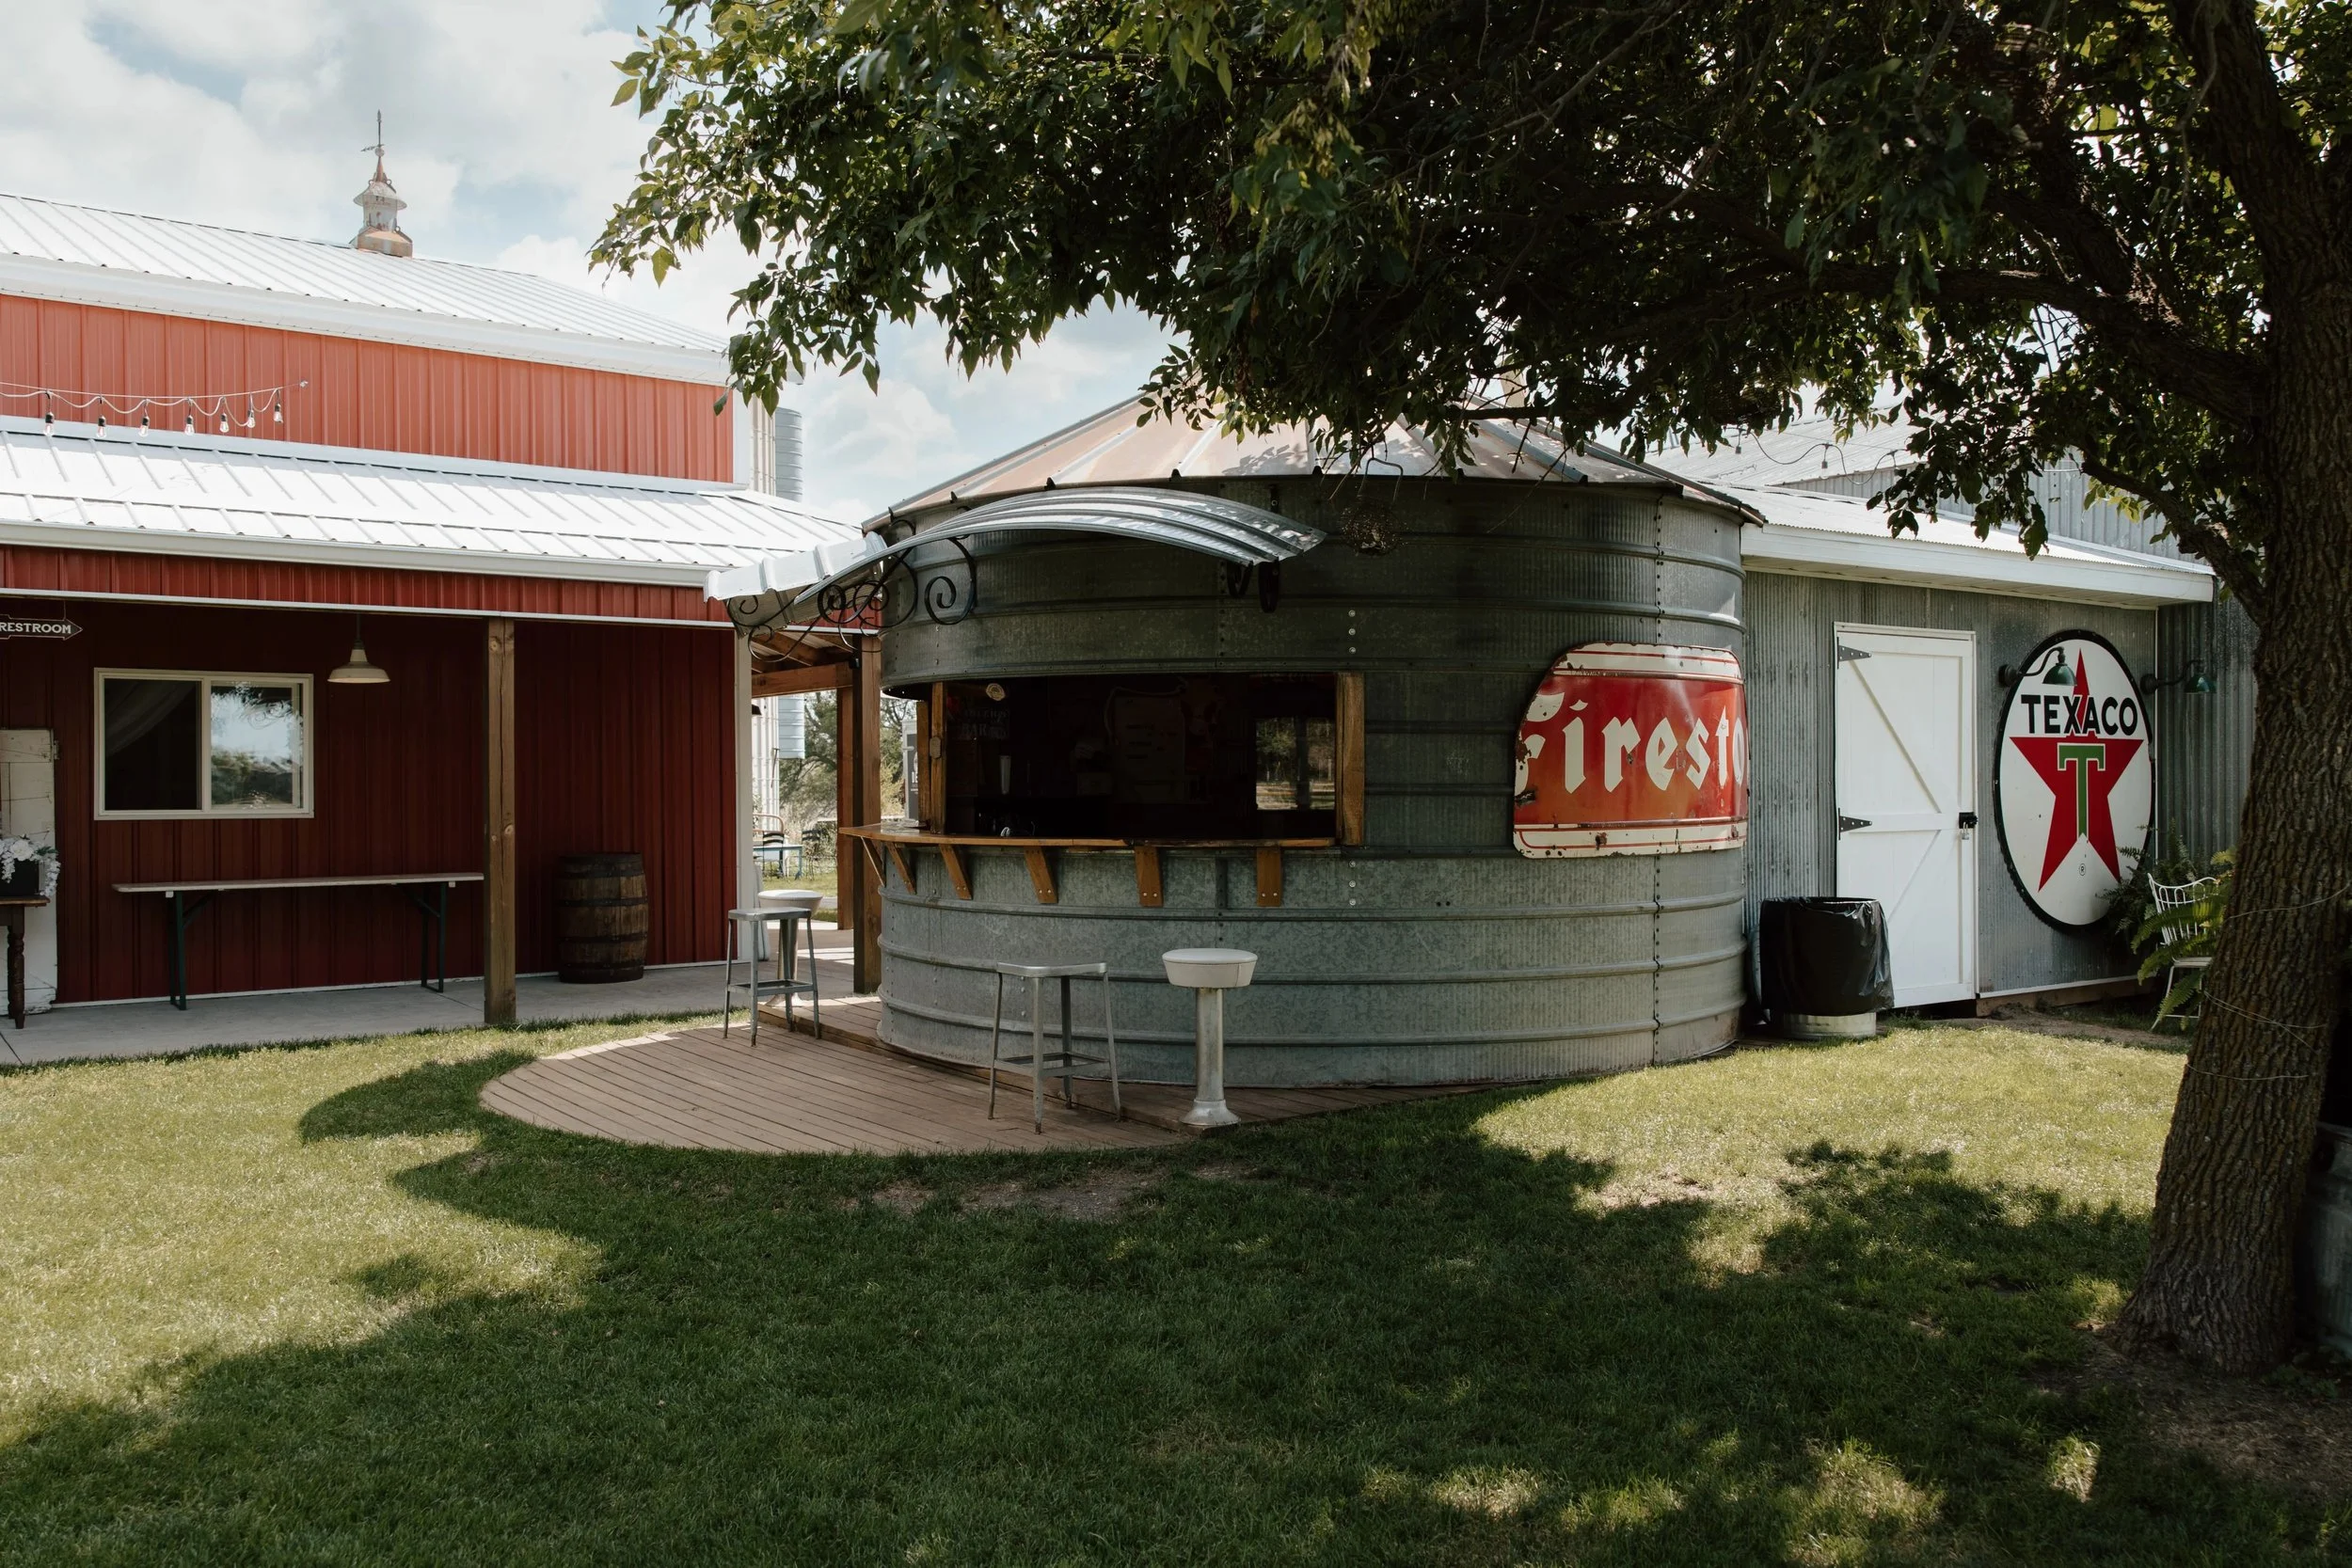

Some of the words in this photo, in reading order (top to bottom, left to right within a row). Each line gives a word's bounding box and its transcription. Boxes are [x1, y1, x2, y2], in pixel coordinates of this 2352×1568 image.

[0, 622, 72, 634] RESTROOM
[2021, 694, 2137, 736] TEXACO
[2058, 743, 2106, 837] T
